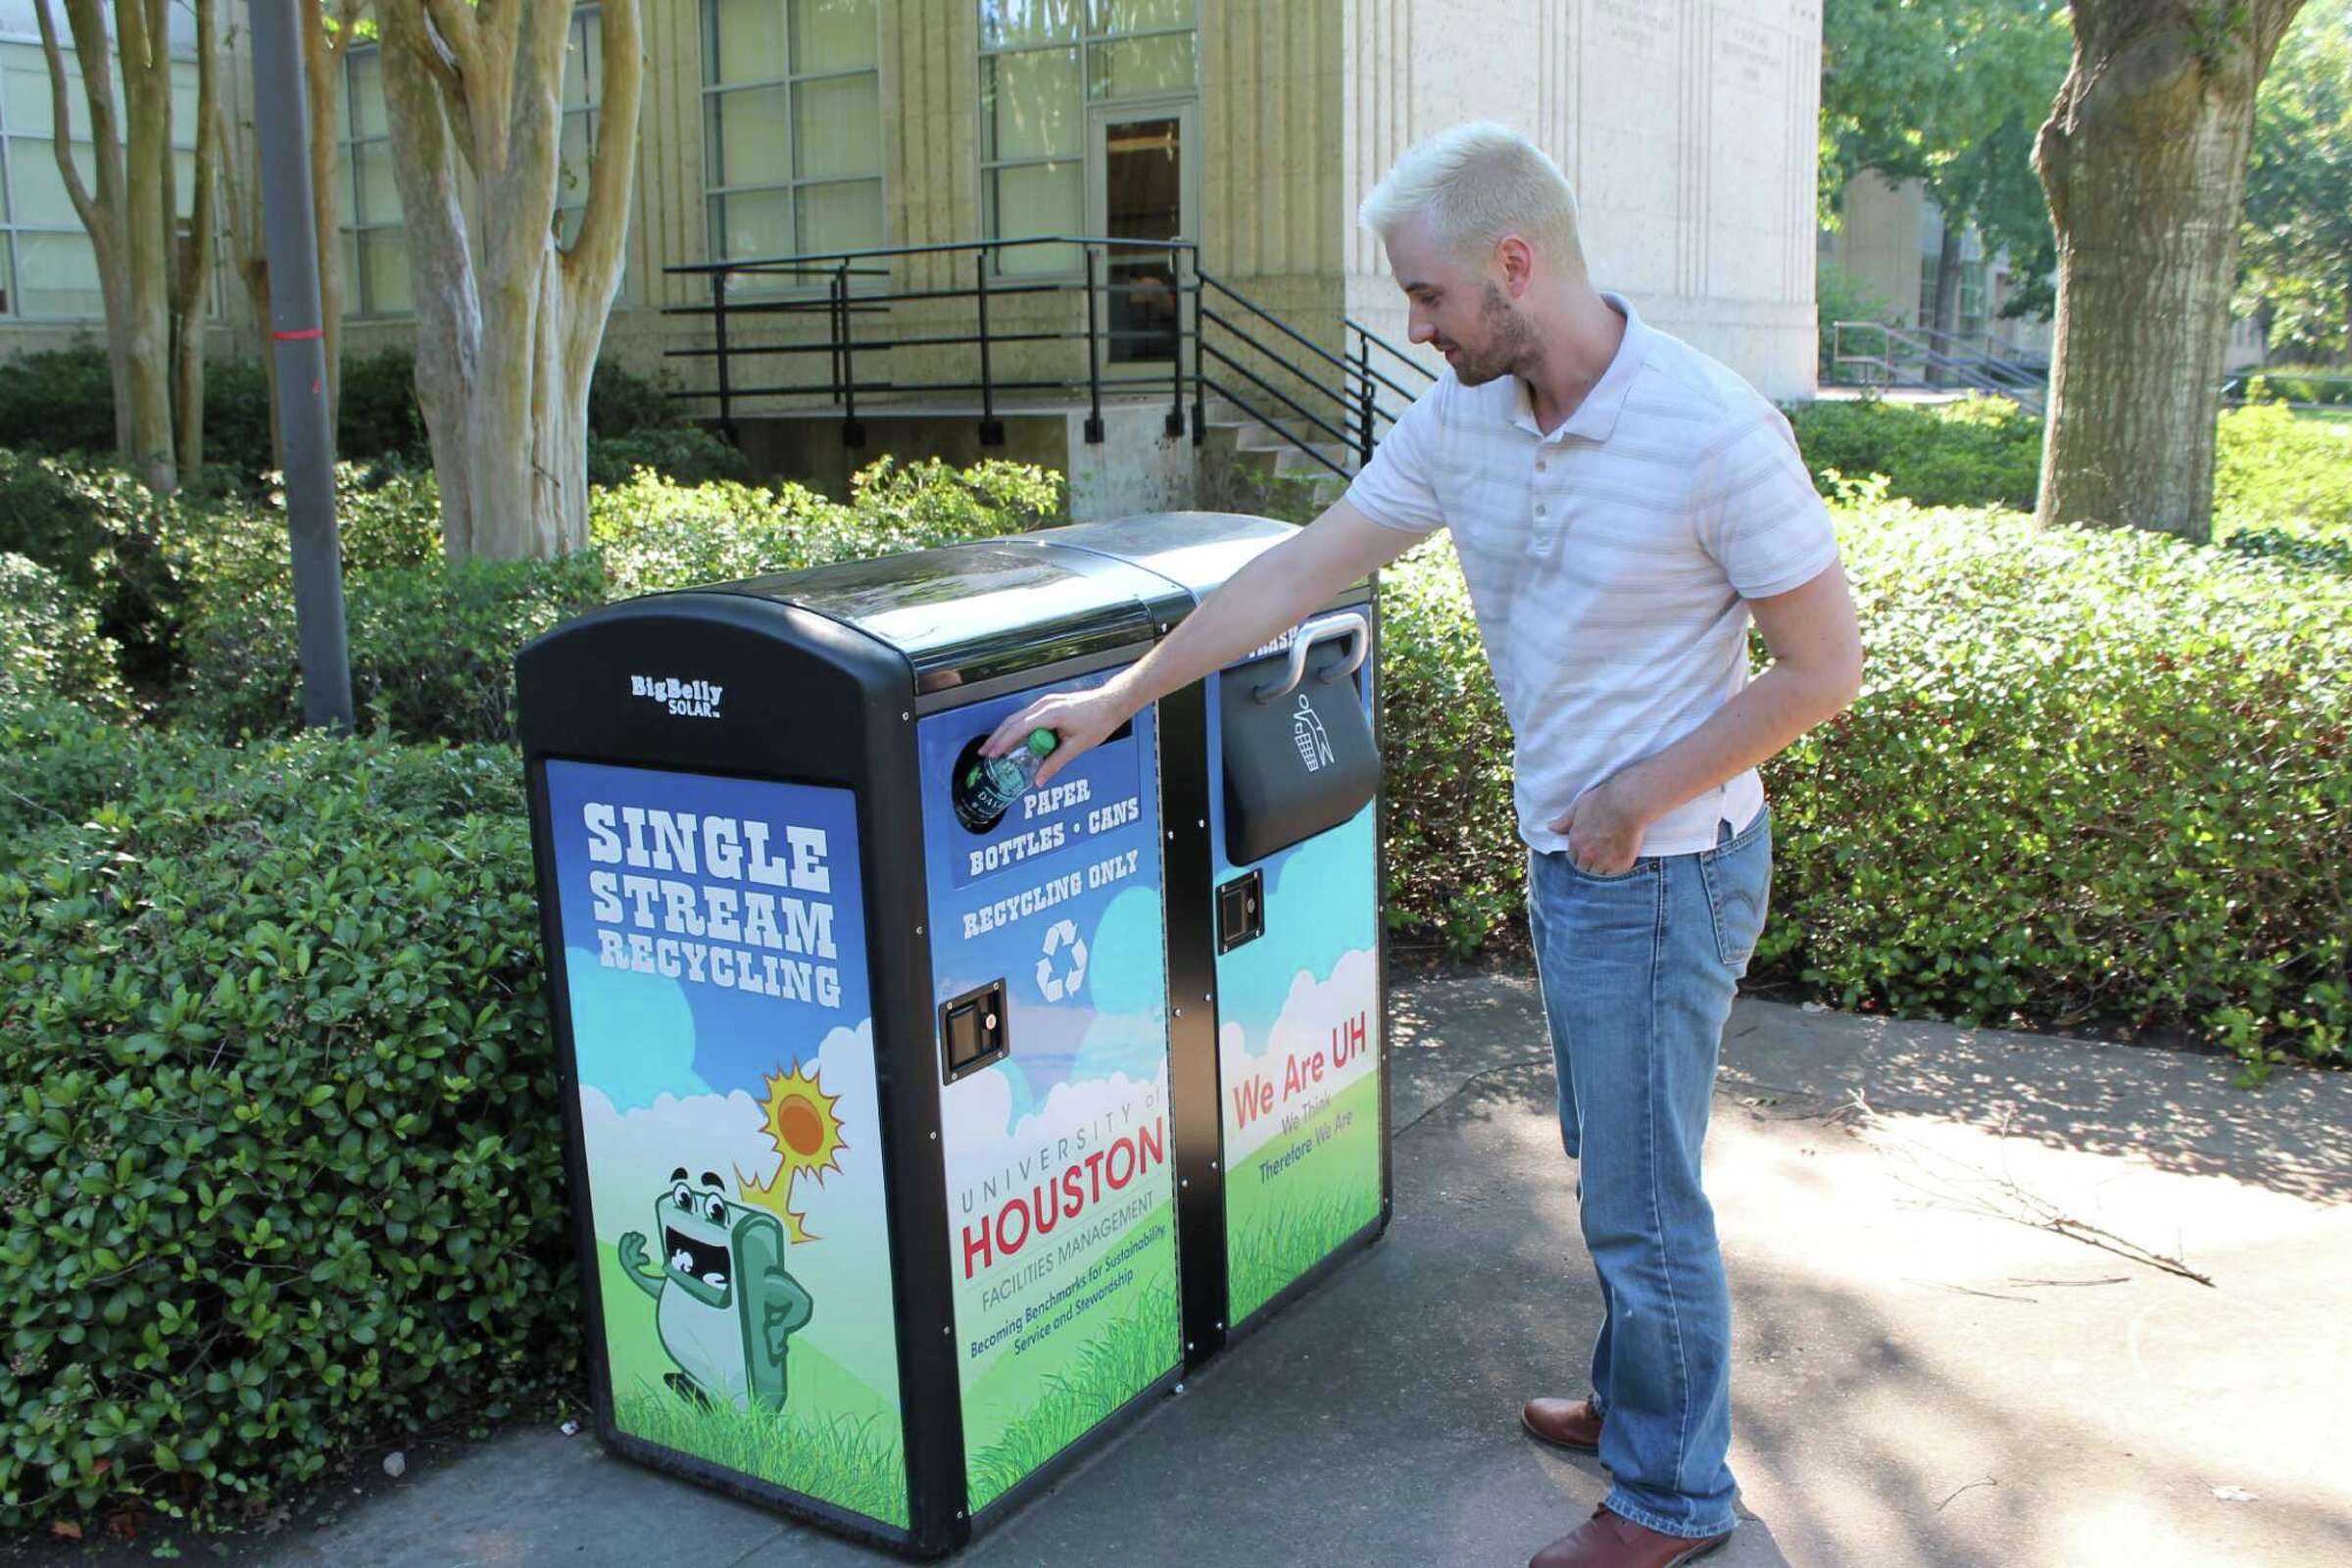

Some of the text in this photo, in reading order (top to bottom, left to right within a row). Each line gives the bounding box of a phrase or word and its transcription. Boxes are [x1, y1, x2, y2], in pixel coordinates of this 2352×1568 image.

[630, 674, 723, 707] BigBelly
[668, 699, 712, 717] SOLAR
[969, 797, 1139, 876] BOTTLES CANS
[1023, 778, 1091, 819] PAPER
[583, 803, 831, 894] SINGLE
[589, 870, 837, 960] STREAM
[962, 849, 1139, 941] RECYCLING ONLY
[597, 928, 843, 1009] RECYCLING
[1233, 1010, 1366, 1129] We Are UH
[1301, 1088, 1333, 1123] Think
[961, 1102, 1131, 1214] UNIVERSITY
[961, 1115, 1164, 1280] HOUSTON
[1259, 1138, 1313, 1185] Therefore
[970, 1225, 1165, 1358] Becoming Benchmarks for Sustainability
[982, 1190, 1154, 1313] FACILITIES MANAGEMENT
[1014, 1267, 1134, 1356] Service and Stewardship
